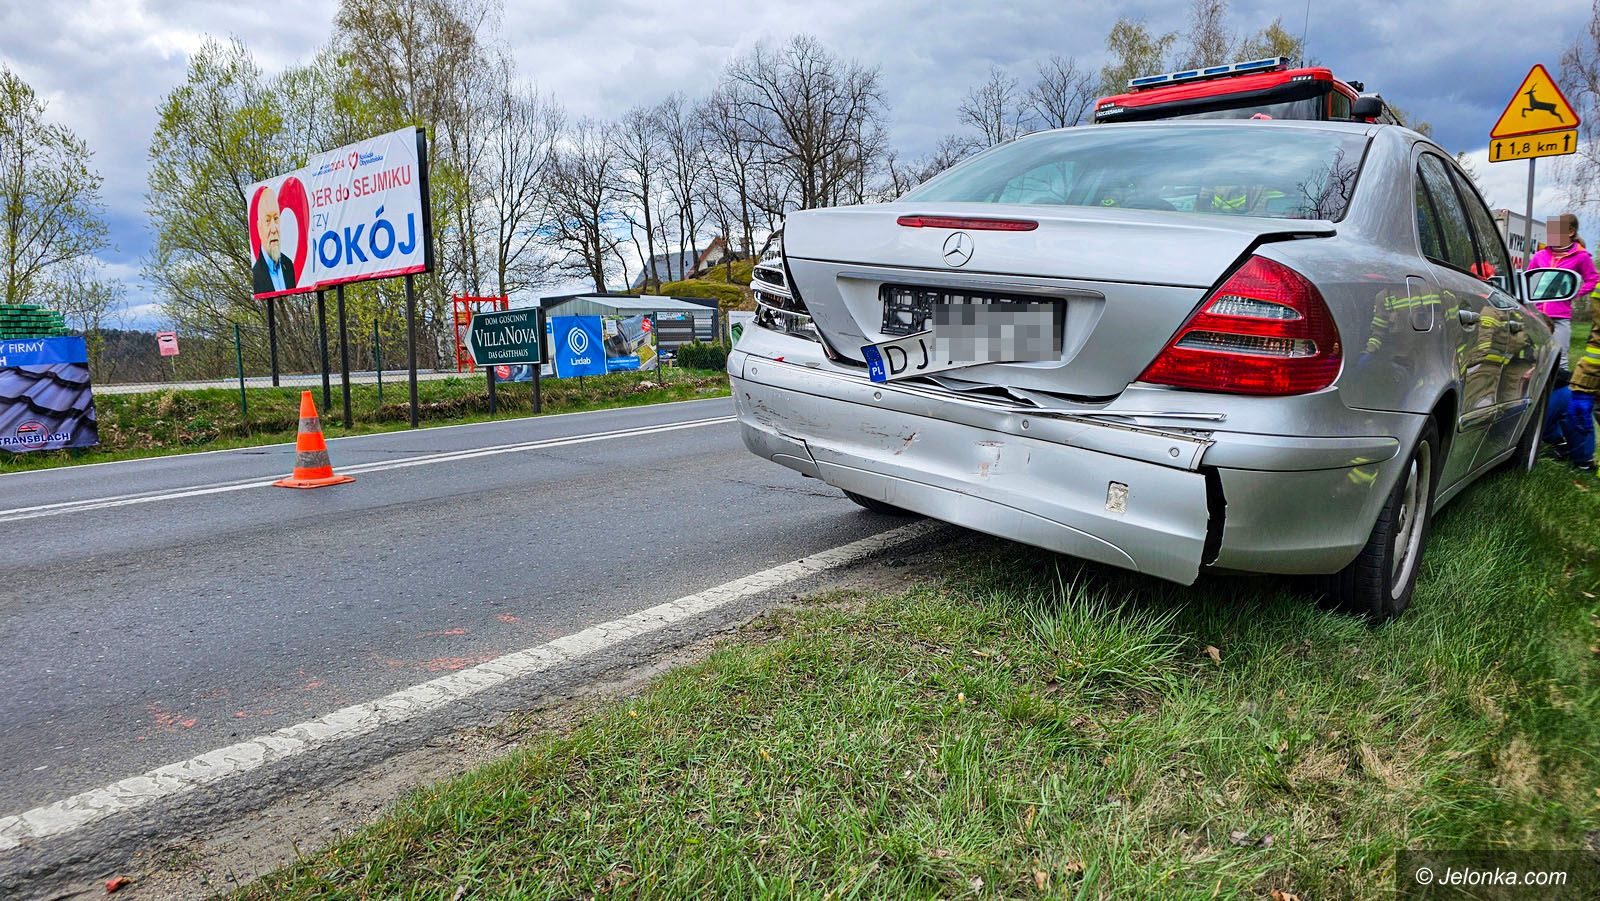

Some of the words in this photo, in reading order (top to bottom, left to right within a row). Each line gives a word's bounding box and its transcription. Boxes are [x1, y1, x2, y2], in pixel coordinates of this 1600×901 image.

[1509, 141, 1530, 155] 1,8
[1537, 142, 1557, 152] km
[336, 184, 350, 203] do
[353, 165, 411, 199] SEJMIKU
[484, 317, 498, 326] DOM
[499, 313, 528, 325] GOŚCINNY
[474, 326, 537, 347] VILLANOVA
[9, 342, 44, 354] FIRMY
[488, 351, 498, 359] DAS
[570, 357, 592, 366] Lindab
[871, 366, 883, 376] PL
